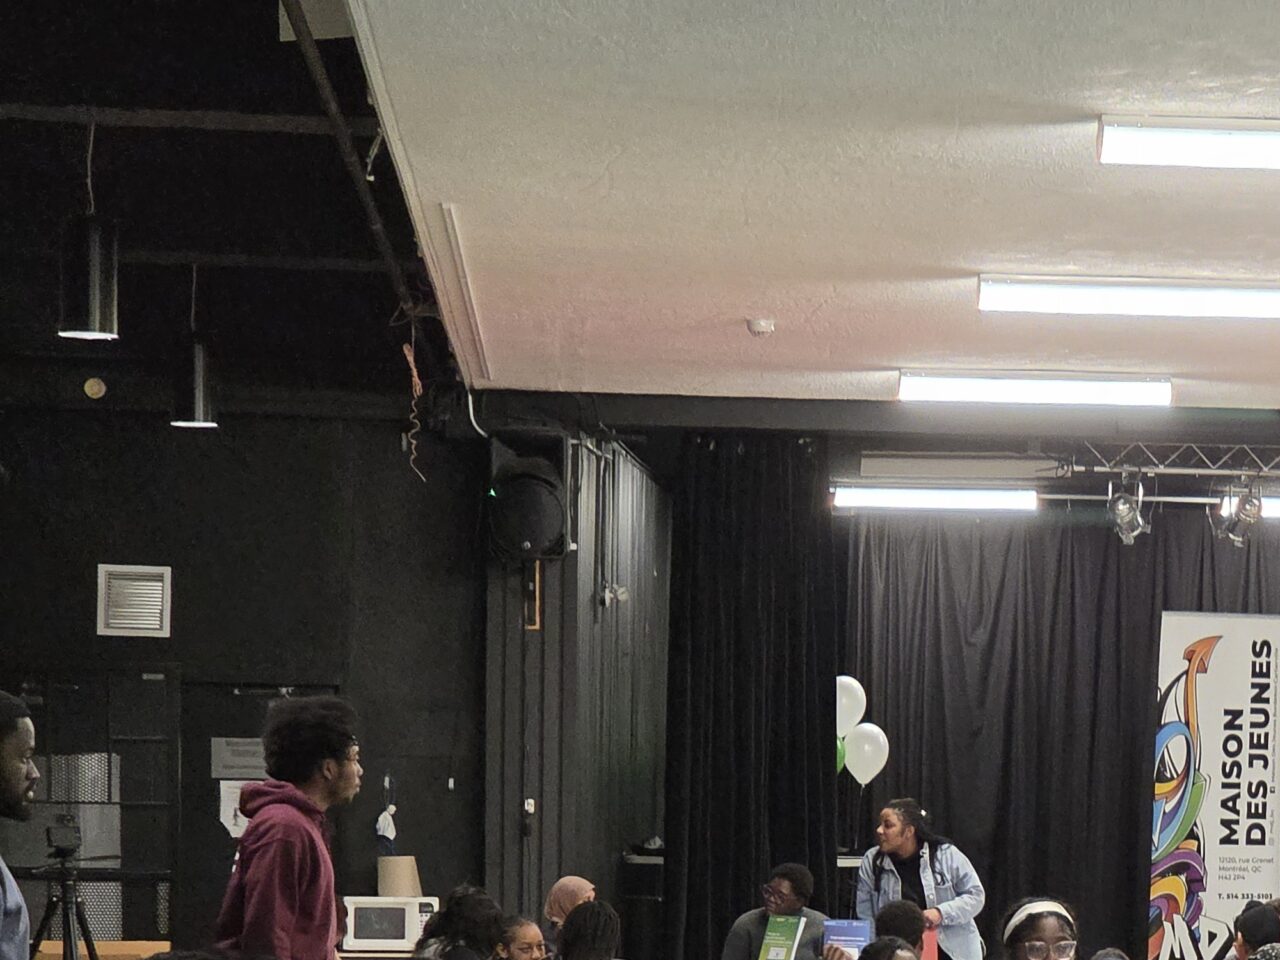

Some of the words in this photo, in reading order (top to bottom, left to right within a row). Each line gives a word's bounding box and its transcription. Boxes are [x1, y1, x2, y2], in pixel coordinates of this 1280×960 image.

[1248, 639, 1272, 770] JEUNES
[1219, 709, 1244, 845] MAISON
[1246, 780, 1268, 846] DES
[1251, 865, 1262, 873] QC
